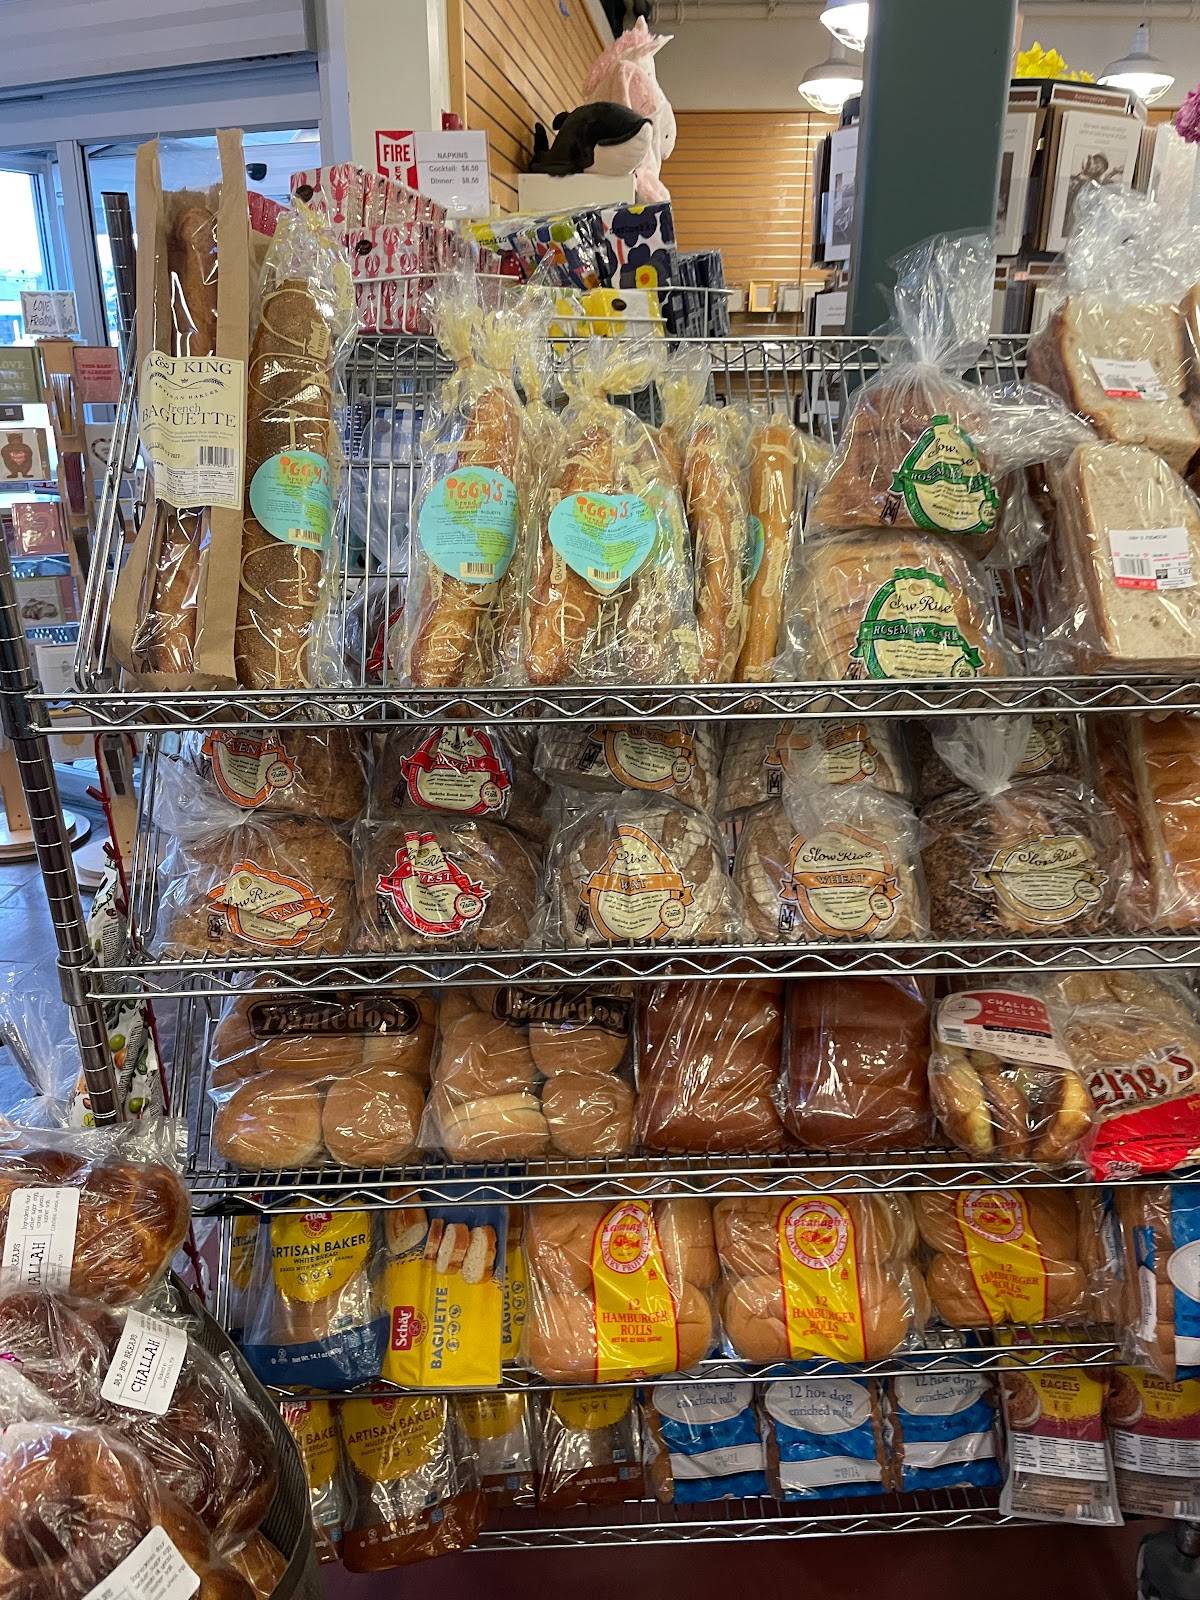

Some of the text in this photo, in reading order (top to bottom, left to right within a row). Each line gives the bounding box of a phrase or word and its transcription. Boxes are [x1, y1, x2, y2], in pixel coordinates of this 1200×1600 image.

[383, 144, 411, 162] FIRE
[184, 361, 232, 375] KING
[168, 402, 201, 414] french
[142, 404, 237, 428] BAGUETTE
[802, 847, 836, 863] Slow
[815, 873, 866, 885] WHEAT
[249, 887, 285, 904] Rise
[270, 902, 307, 921] RAIN
[987, 998, 1045, 1013] CHALLAH
[998, 1006, 1036, 1017] ROLLS
[272, 1233, 366, 1259] ARTISAN BAKER
[293, 1256, 316, 1265] WHITE
[1000, 1264, 1013, 1273] 12
[981, 1270, 1039, 1286] HAMBURGER
[628, 1299, 641, 1311] 12
[815, 1296, 828, 1307] 12
[603, 1311, 667, 1323] HAMBURGER
[792, 1308, 856, 1323] HAMBURGER
[395, 1310, 412, 1347] Schär
[431, 1287, 448, 1369] BAGUETTE
[620, 1324, 652, 1336] ROLLS
[809, 1320, 839, 1332] ROLLS
[131, 1338, 161, 1393] CHALLAH
[1040, 1378, 1081, 1392] BAGELS
[1142, 1378, 1184, 1393] BAGELS
[789, 1384, 853, 1406] 12 hot dog
[789, 1404, 830, 1416] enriched
[348, 1423, 397, 1445] ARTISAN
